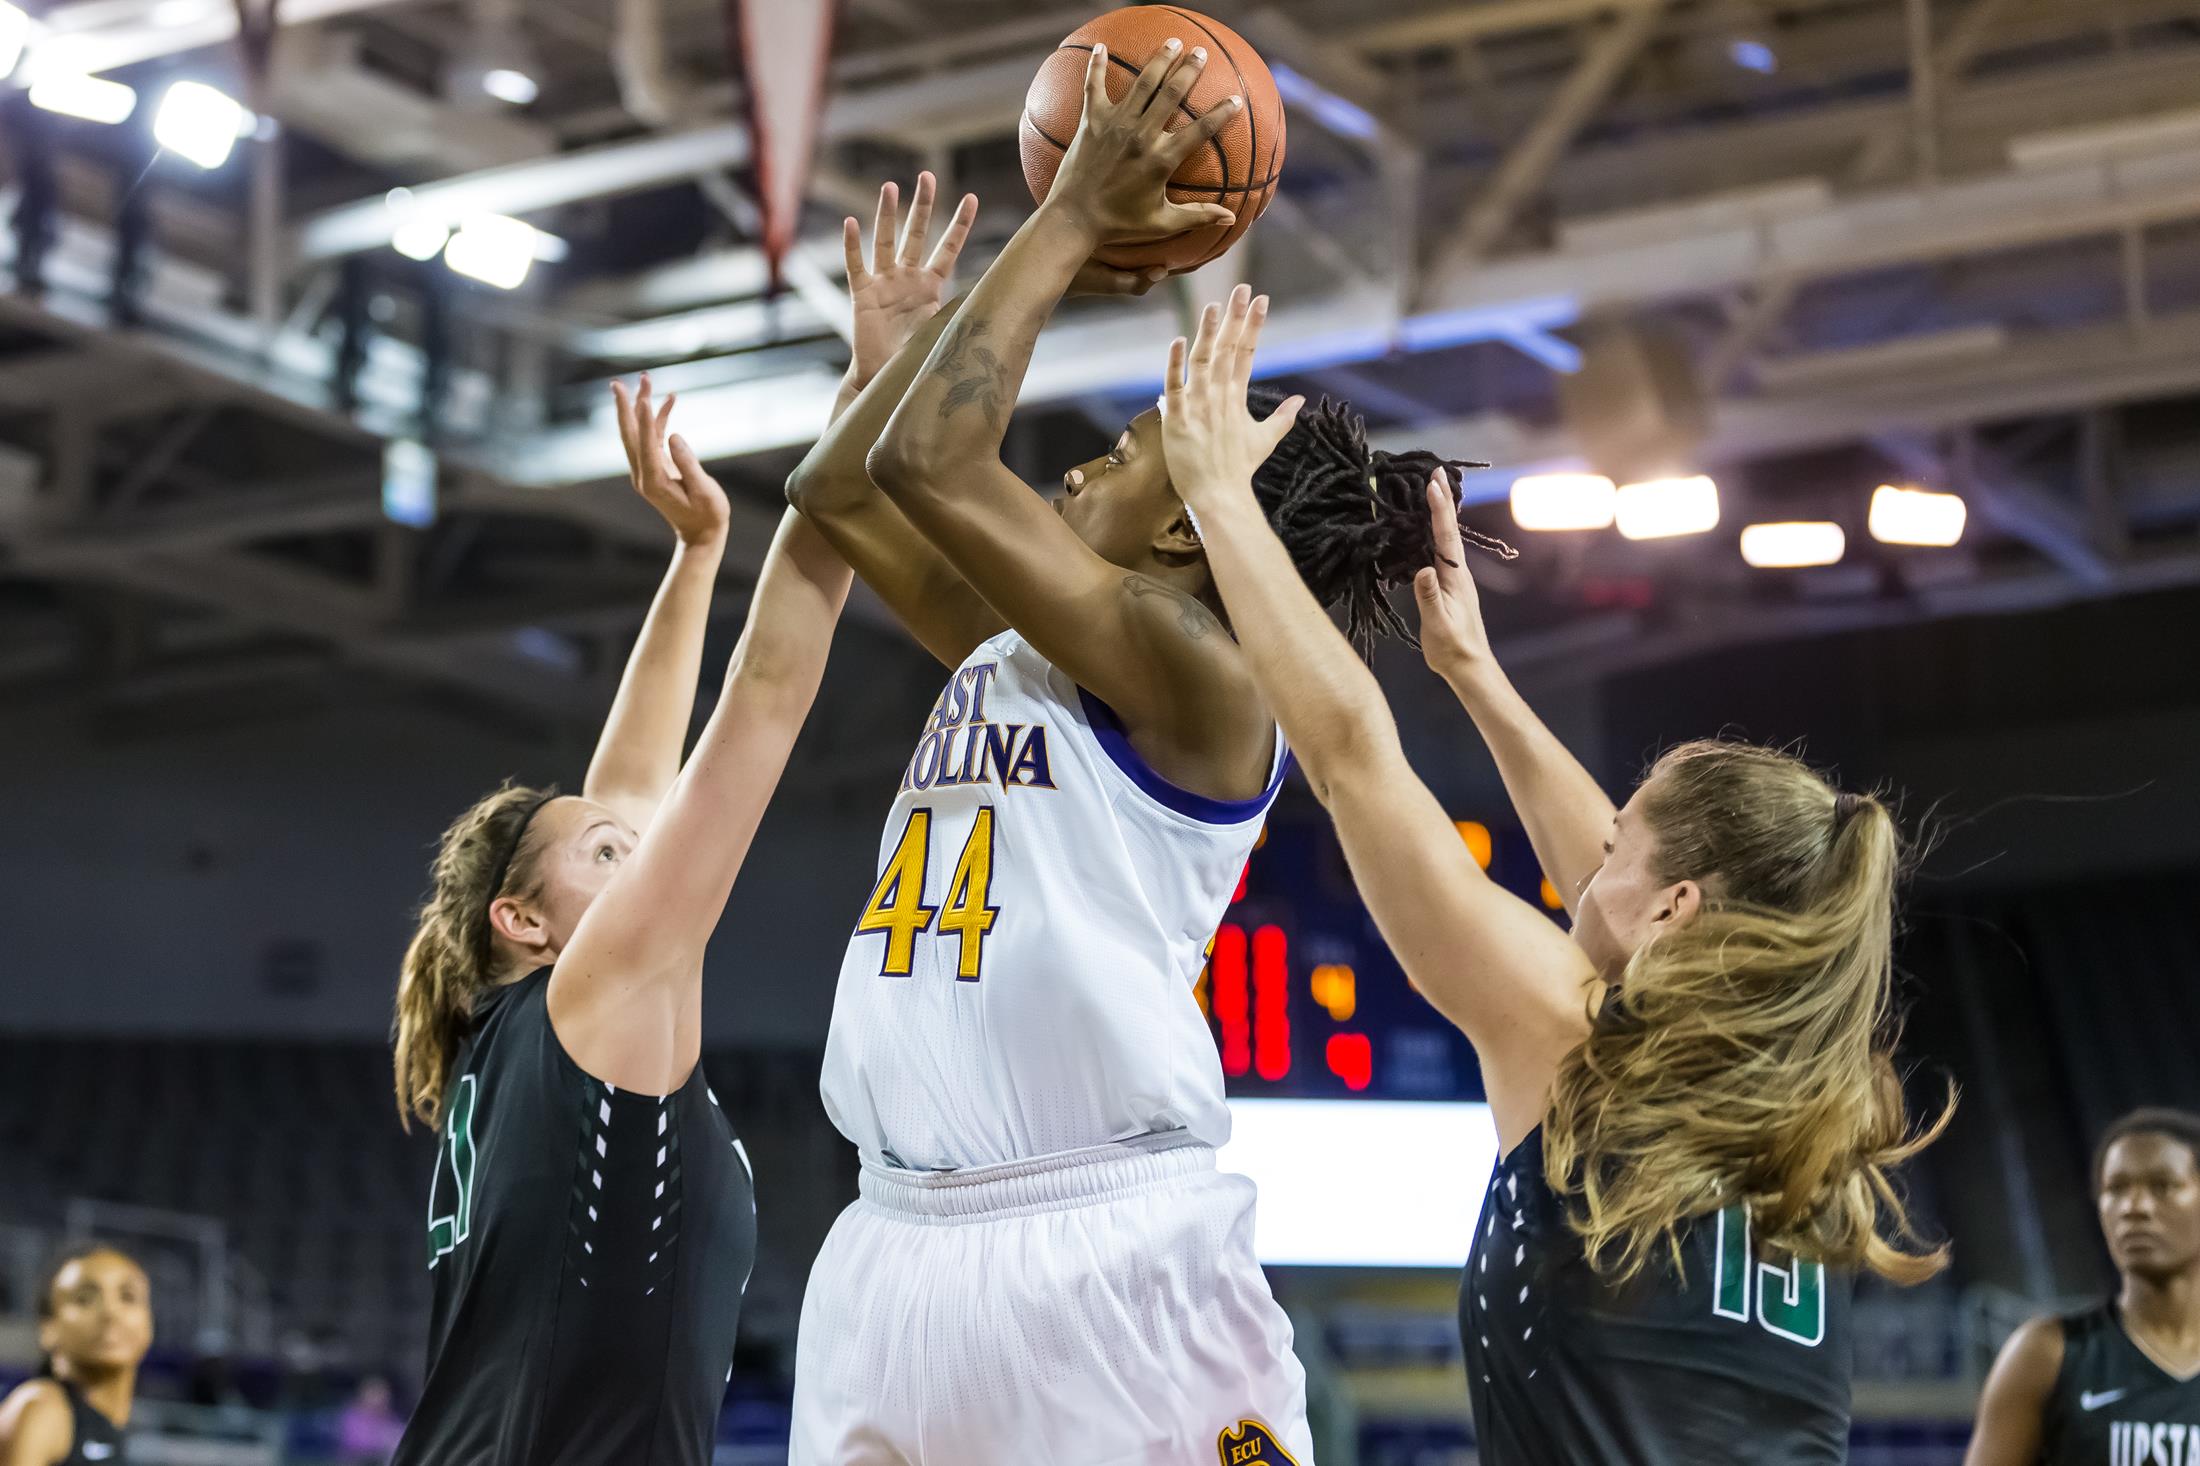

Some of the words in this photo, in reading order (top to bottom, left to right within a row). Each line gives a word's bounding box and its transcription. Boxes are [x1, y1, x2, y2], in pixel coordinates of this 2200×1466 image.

[923, 662, 998, 730] AST
[899, 724, 1058, 795] OLINA
[855, 807, 999, 982] 44
[1230, 1437, 1261, 1465] ECU
